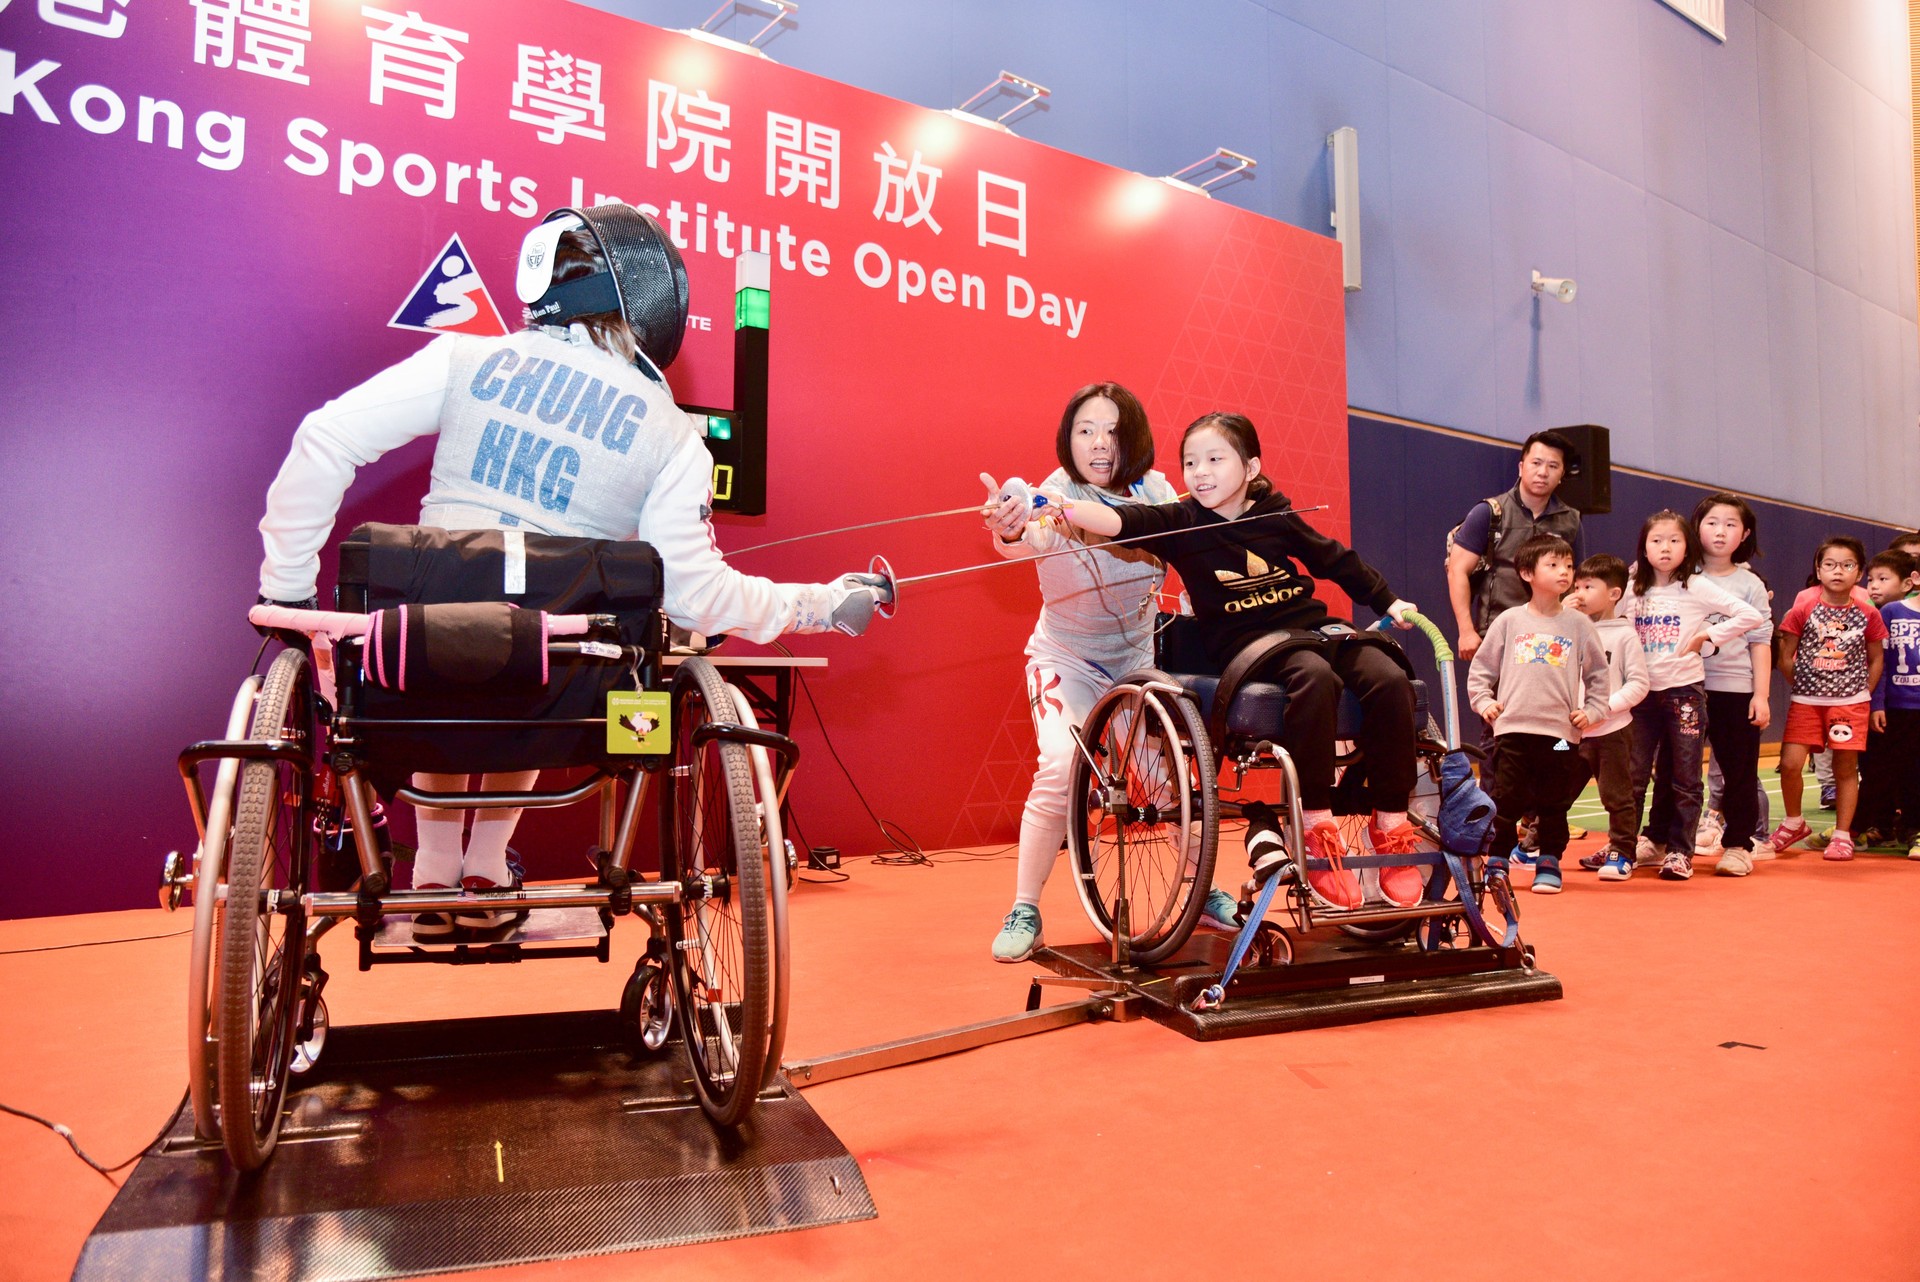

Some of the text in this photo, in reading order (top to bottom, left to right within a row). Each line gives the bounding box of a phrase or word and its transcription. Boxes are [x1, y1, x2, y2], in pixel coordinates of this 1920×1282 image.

[0, 48, 246, 171] Kong
[283, 117, 539, 219] Sports
[854, 242, 986, 311] Open
[1007, 275, 1088, 339] Day
[470, 348, 648, 455] CHUNG
[470, 419, 581, 514] HKG
[1634, 615, 1681, 626] makes
